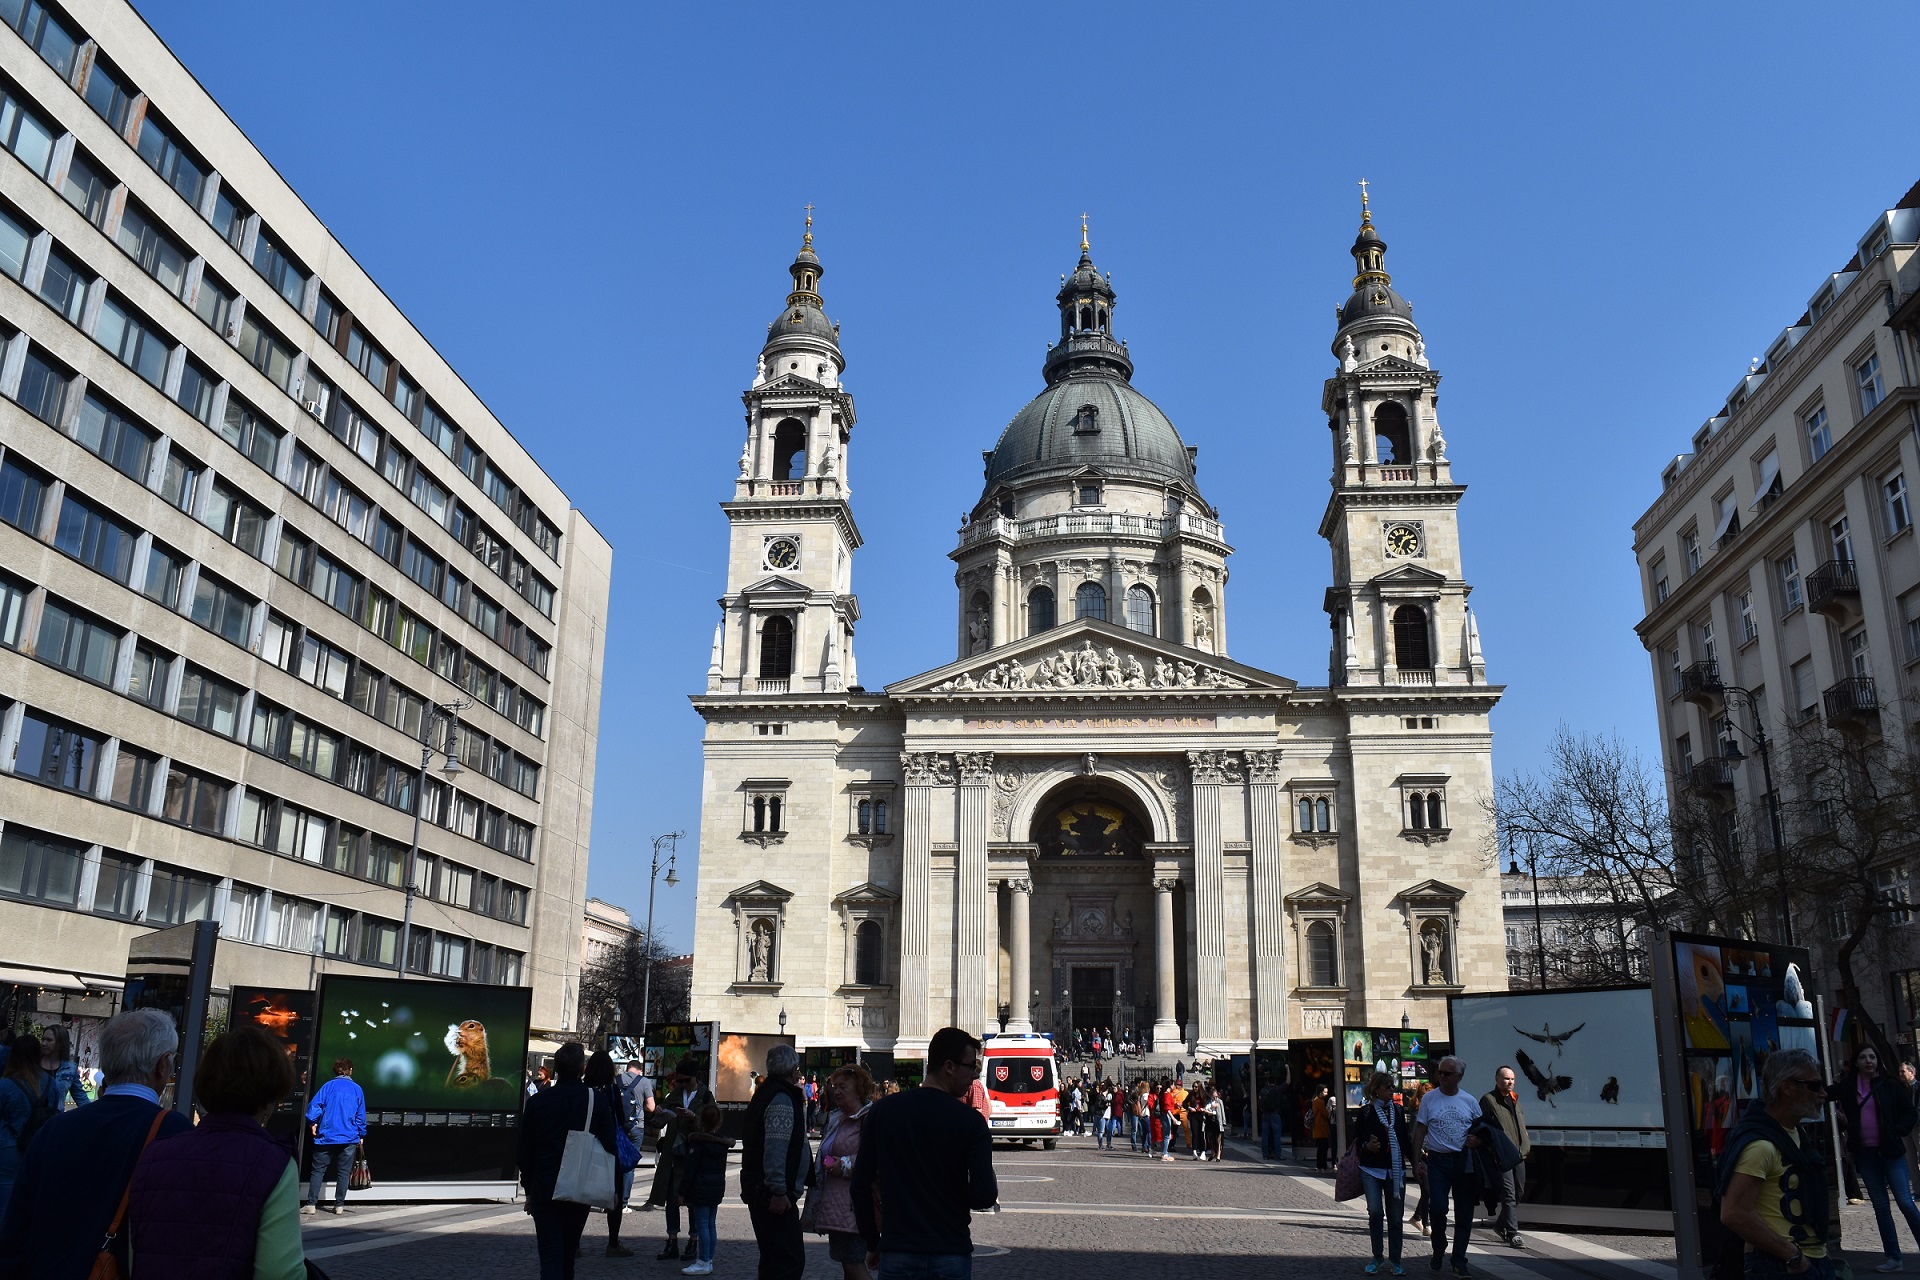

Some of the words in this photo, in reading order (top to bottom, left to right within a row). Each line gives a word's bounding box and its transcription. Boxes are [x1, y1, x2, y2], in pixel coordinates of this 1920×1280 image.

[978, 718, 1005, 730] EGO
[1013, 718, 1044, 729] SUM
[1085, 717, 1140, 729] VERITAS
[1148, 716, 1163, 728] ET
